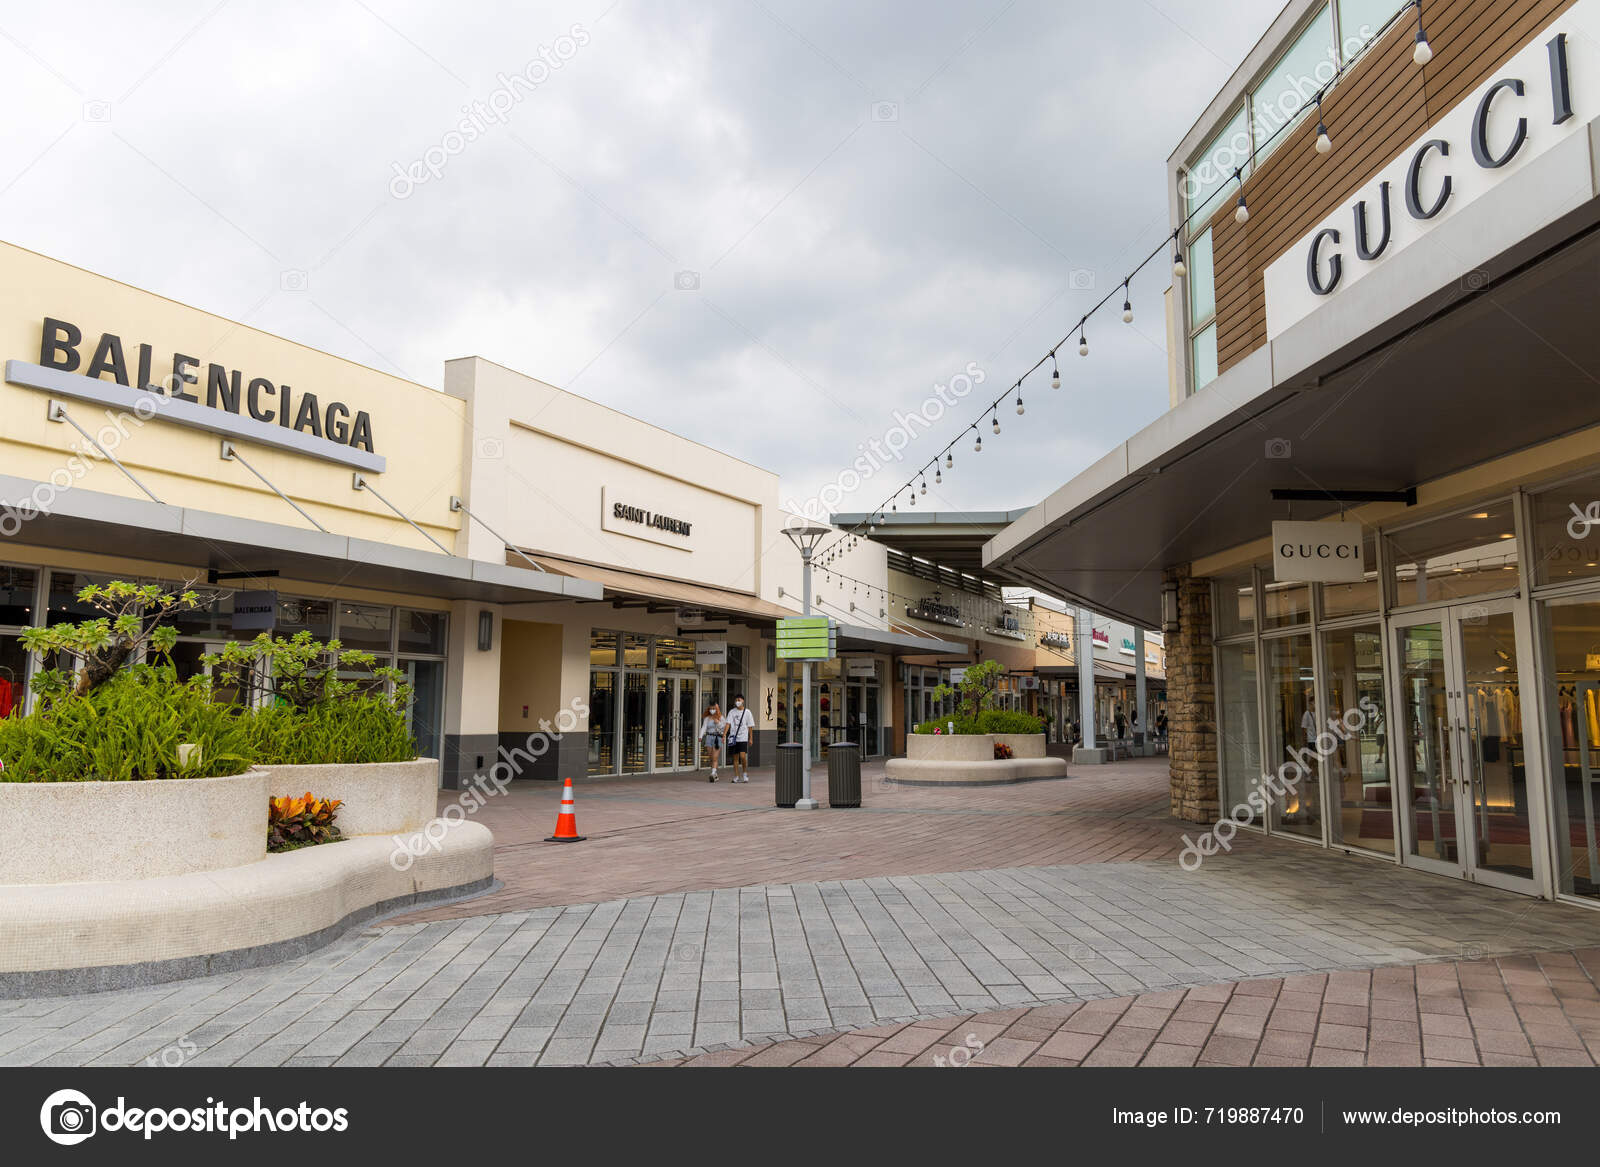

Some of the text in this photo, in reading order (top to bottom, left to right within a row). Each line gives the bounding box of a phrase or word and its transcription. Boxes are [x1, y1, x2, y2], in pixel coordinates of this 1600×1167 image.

[1307, 33, 1574, 295] GUCCI
[40, 317, 375, 454] BALENCIAGA
[613, 502, 692, 536] SAINT LAURENT
[1280, 543, 1358, 559] GUCCI
